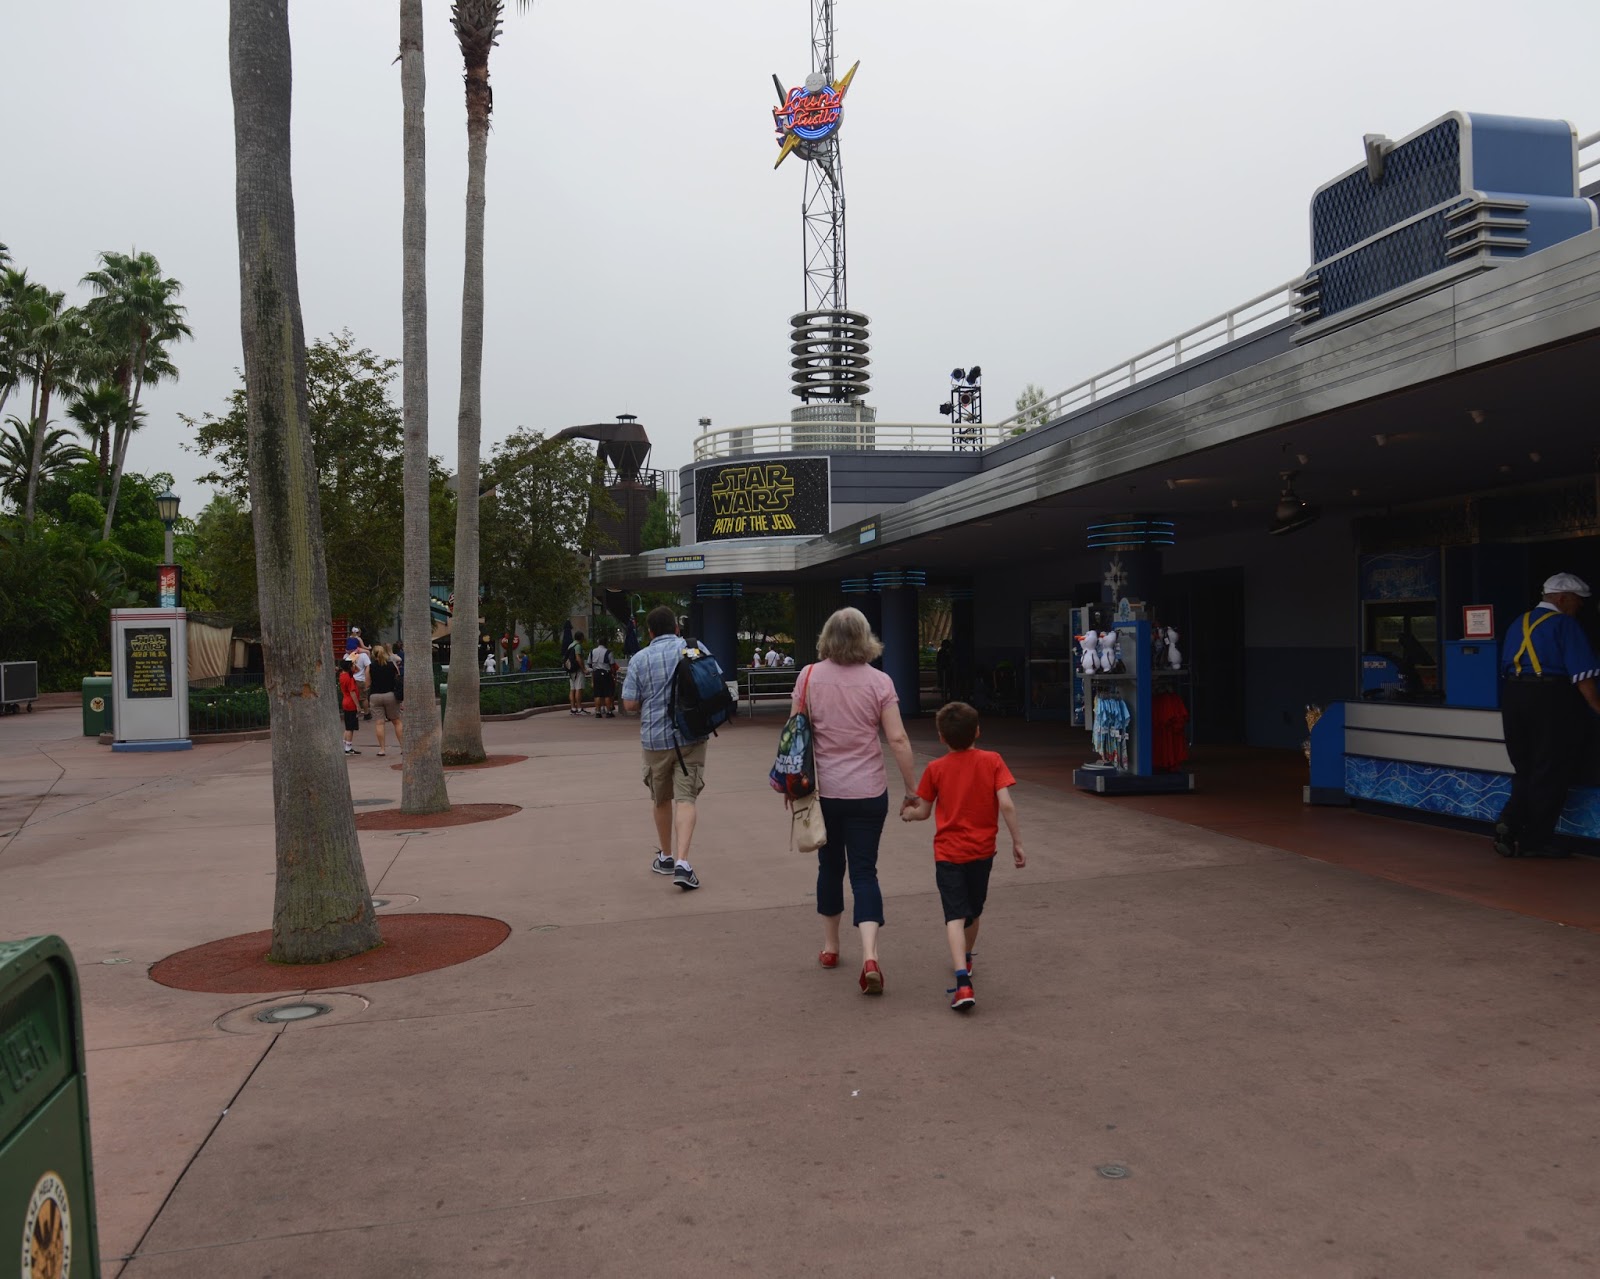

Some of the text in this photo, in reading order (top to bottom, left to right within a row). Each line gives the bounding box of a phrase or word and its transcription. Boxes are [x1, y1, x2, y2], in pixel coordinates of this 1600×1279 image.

[774, 86, 845, 113] Sound
[784, 109, 839, 129] Studio
[712, 465, 794, 493] STAR
[712, 487, 794, 515] WARS
[712, 514, 796, 534] PATH OF THE JEDI
[131, 634, 167, 644] STAR
[131, 642, 166, 651] WARS
[775, 761, 803, 774] WARS
[776, 754, 804, 765] STAR
